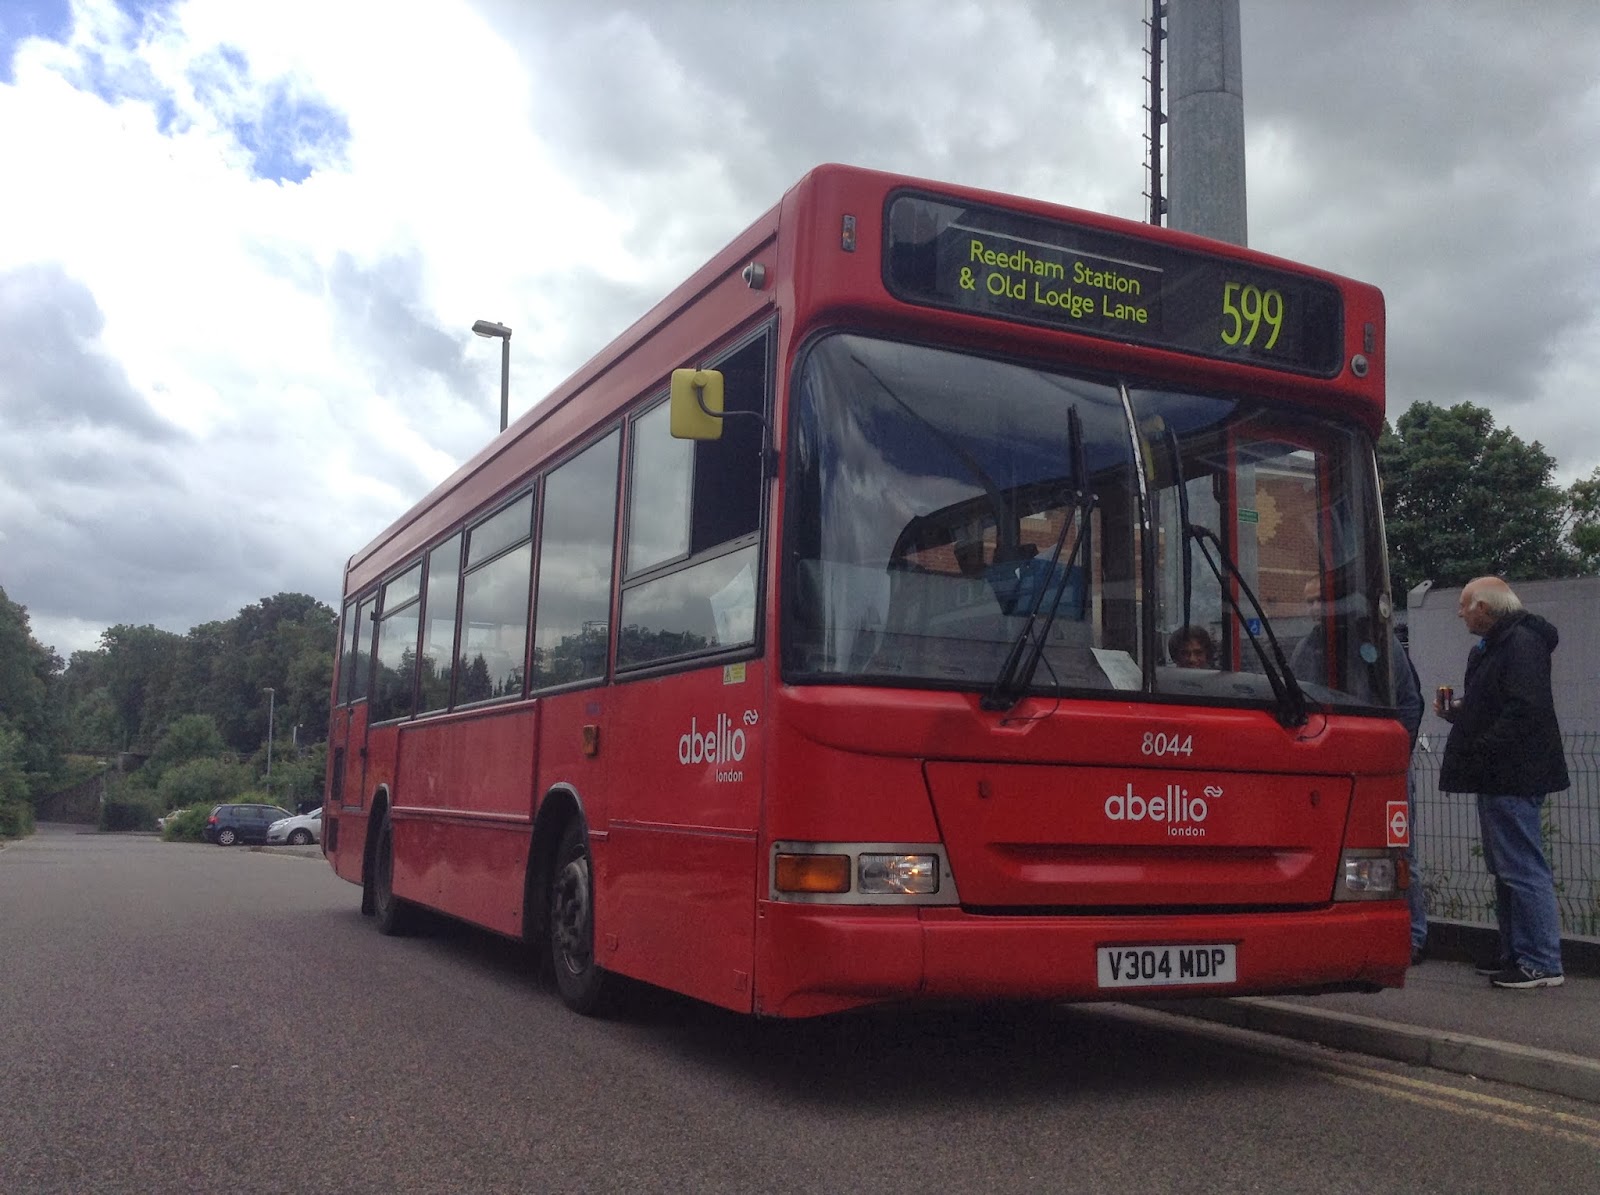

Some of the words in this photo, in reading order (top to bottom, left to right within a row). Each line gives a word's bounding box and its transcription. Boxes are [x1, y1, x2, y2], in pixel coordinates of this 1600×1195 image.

[970, 239, 1064, 279] Reedham
[1073, 261, 1141, 295] Station
[959, 267, 975, 291] &
[986, 273, 1026, 300] Old
[1035, 281, 1094, 318] Lodge
[1103, 294, 1148, 323] Lane
[1221, 281, 1284, 350] 599
[678, 713, 746, 765] abellio
[1141, 731, 1193, 757] 8044
[715, 769, 743, 782] london
[1104, 783, 1208, 823] abellio
[1167, 826, 1206, 837] london
[1109, 950, 1172, 981] V304
[1180, 949, 1226, 978] MDP
